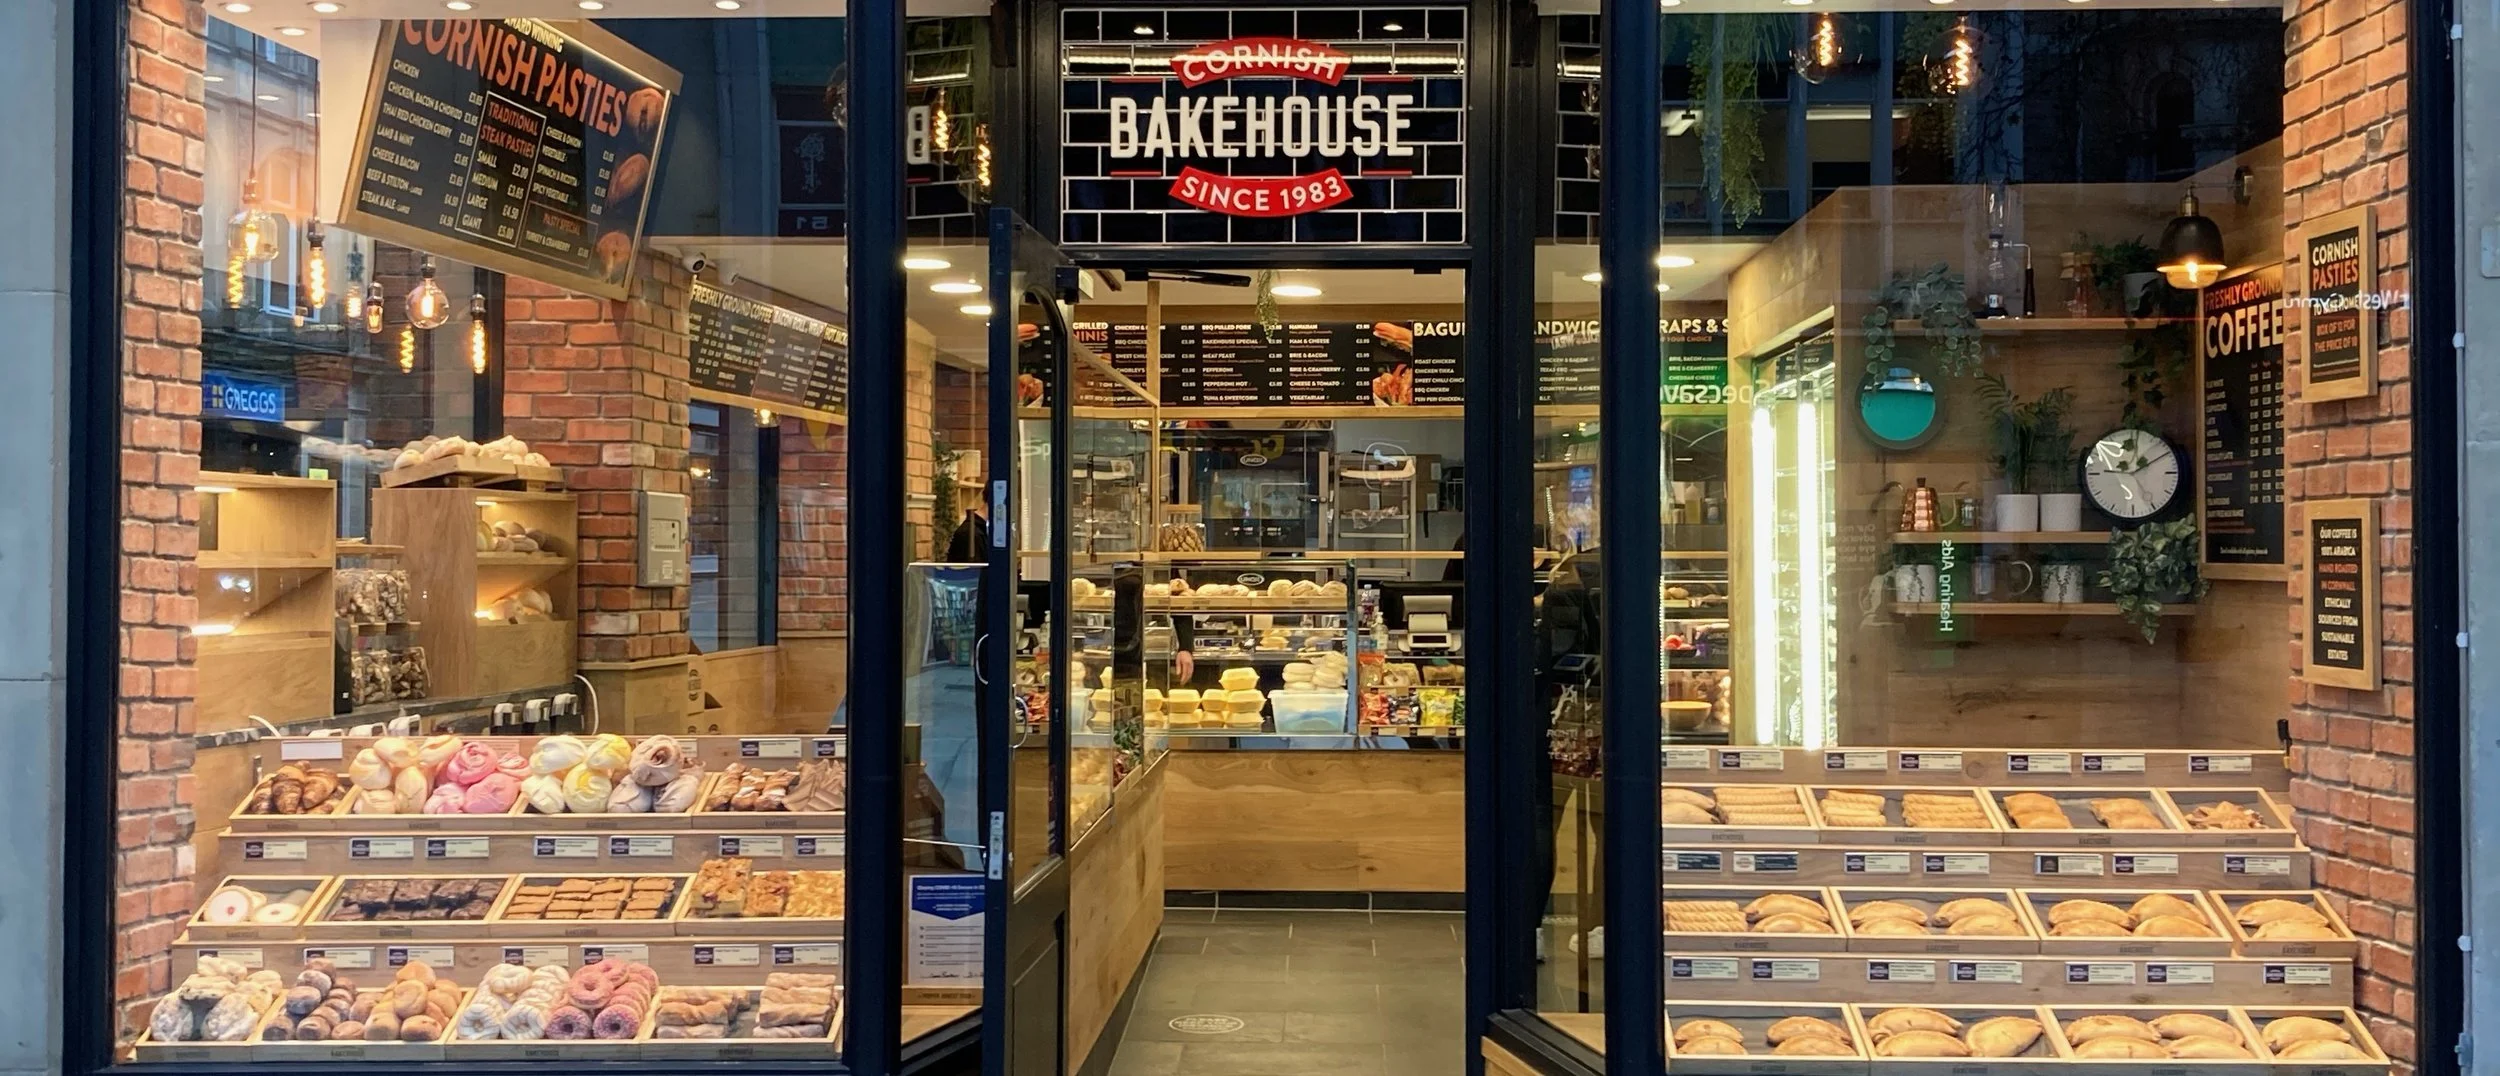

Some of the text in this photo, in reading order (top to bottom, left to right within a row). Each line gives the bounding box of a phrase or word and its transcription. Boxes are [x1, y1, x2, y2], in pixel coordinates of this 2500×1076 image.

[504, 17, 565, 53] AWARD WINNING
[393, 59, 420, 78] CHICKEN
[1183, 43, 1338, 81] CORNISH
[404, 18, 627, 137] CORNISH PASTIES
[415, 92, 434, 108] BACON
[383, 103, 452, 138] THAI RED CHICKEN CURRY
[489, 102, 539, 136] TRADITIONAL
[1110, 94, 1414, 159] BAKEHOUSE
[377, 124, 392, 140] LAMB
[399, 132, 415, 146] MINT
[480, 124, 535, 159] STEAK PASTIES
[372, 146, 420, 171] CHEESE BACON
[477, 150, 529, 180] SMALL £2.00
[366, 168, 381, 182] BEEF
[386, 175, 409, 189] STILTON
[472, 172, 499, 191] MEDIUM
[361, 190, 380, 206] STEAK
[385, 197, 397, 210] ALE
[467, 193, 519, 220] LARGE £4.50
[1181, 176, 1343, 212] SINCE 1983
[462, 214, 482, 229] GIANT
[2313, 237, 2358, 266] CORNISH
[2313, 259, 2358, 291] PASTIES
[691, 284, 774, 323] FRESHLY GROUND COFFEE
[2205, 278, 2283, 310] FRESHLY GROUND
[2314, 303, 2322, 316] TO
[1072, 322, 1108, 330] GRILLED
[1706, 319, 1718, 333] &
[2206, 299, 2284, 358] COFFEE
[2328, 322, 2338, 333] OF
[2345, 319, 2356, 331] FOR
[2315, 342, 2326, 353] THE
[2326, 338, 2342, 351] PRICE
[2343, 337, 2351, 349] OF
[225, 387, 276, 414] GREGGS
[2320, 528, 2357, 539] OUR COFFEE IS
[2333, 546, 2356, 556] ARABICA
[2318, 614, 2358, 626] SOURCED FROM
